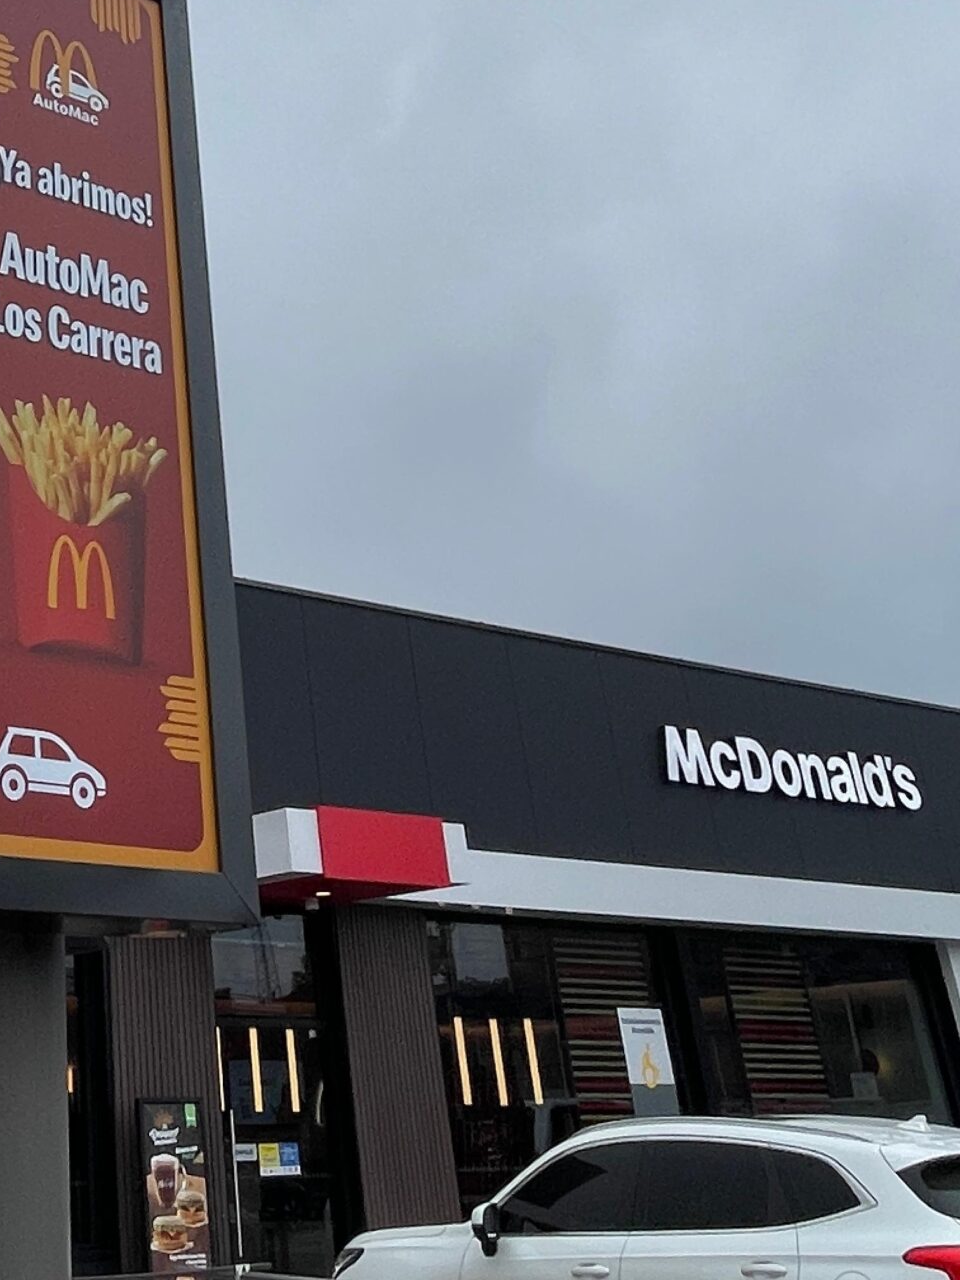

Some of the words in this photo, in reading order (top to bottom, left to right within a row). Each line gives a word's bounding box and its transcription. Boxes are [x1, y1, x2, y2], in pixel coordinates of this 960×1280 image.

[32, 92, 100, 126] AutoMac
[37, 162, 154, 228] abrimos!
[47, 304, 163, 375] Carrera
[664, 724, 923, 811] McDonald's
